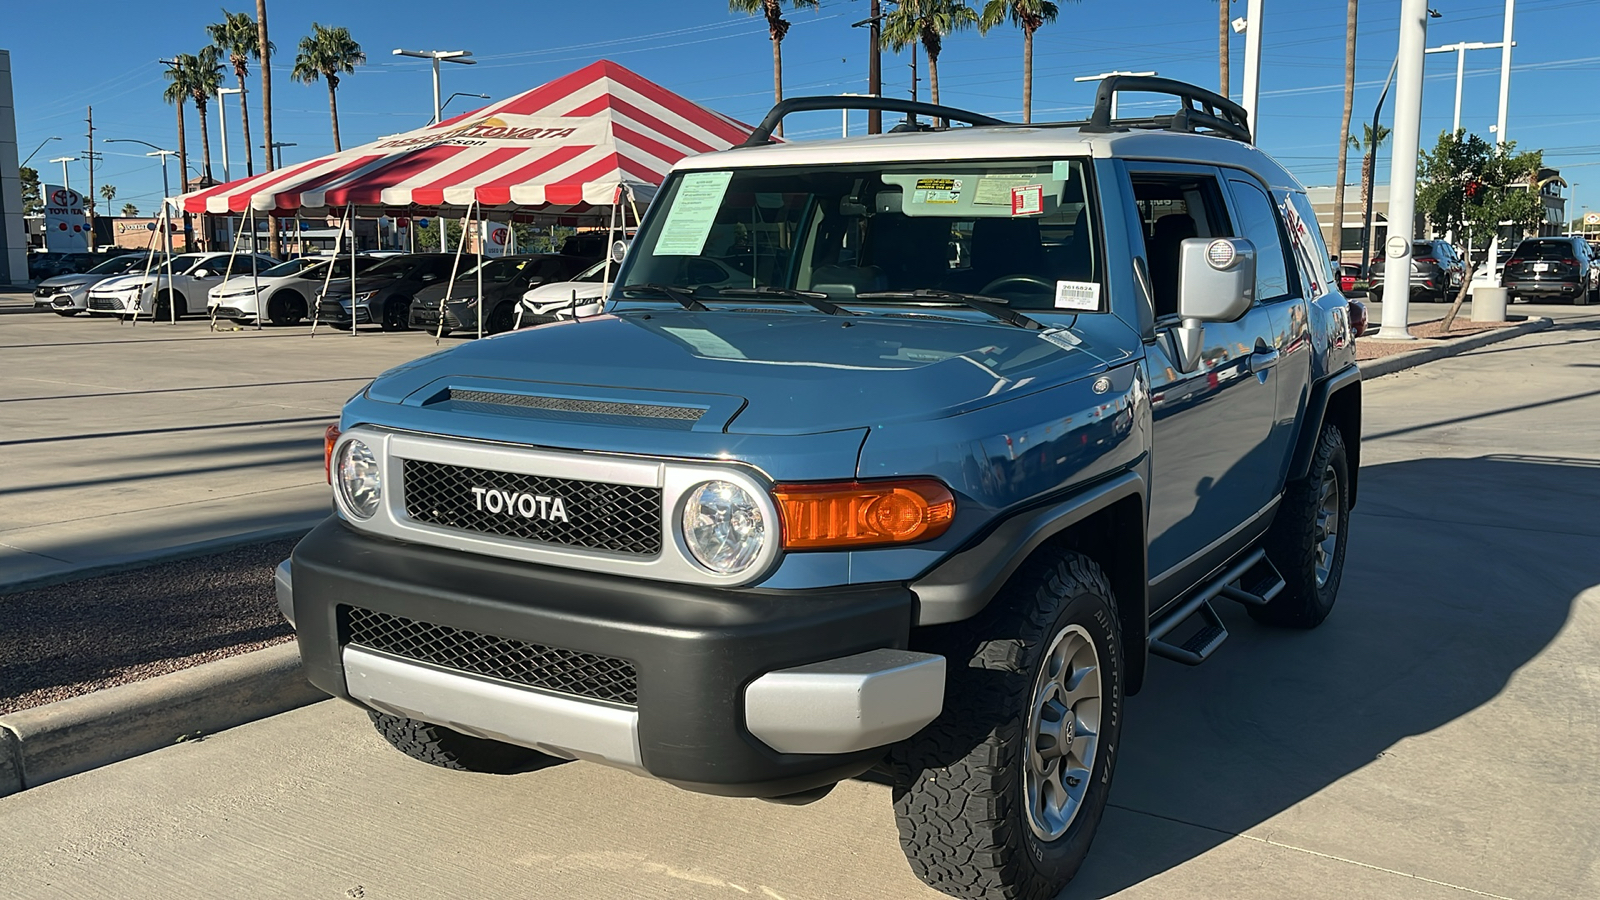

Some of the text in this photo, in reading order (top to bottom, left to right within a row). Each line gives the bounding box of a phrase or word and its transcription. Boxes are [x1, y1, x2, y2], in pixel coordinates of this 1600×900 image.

[467, 125, 578, 139] TOYOTA
[48, 207, 84, 215] TOYTA
[471, 486, 569, 523] TOYOTA
